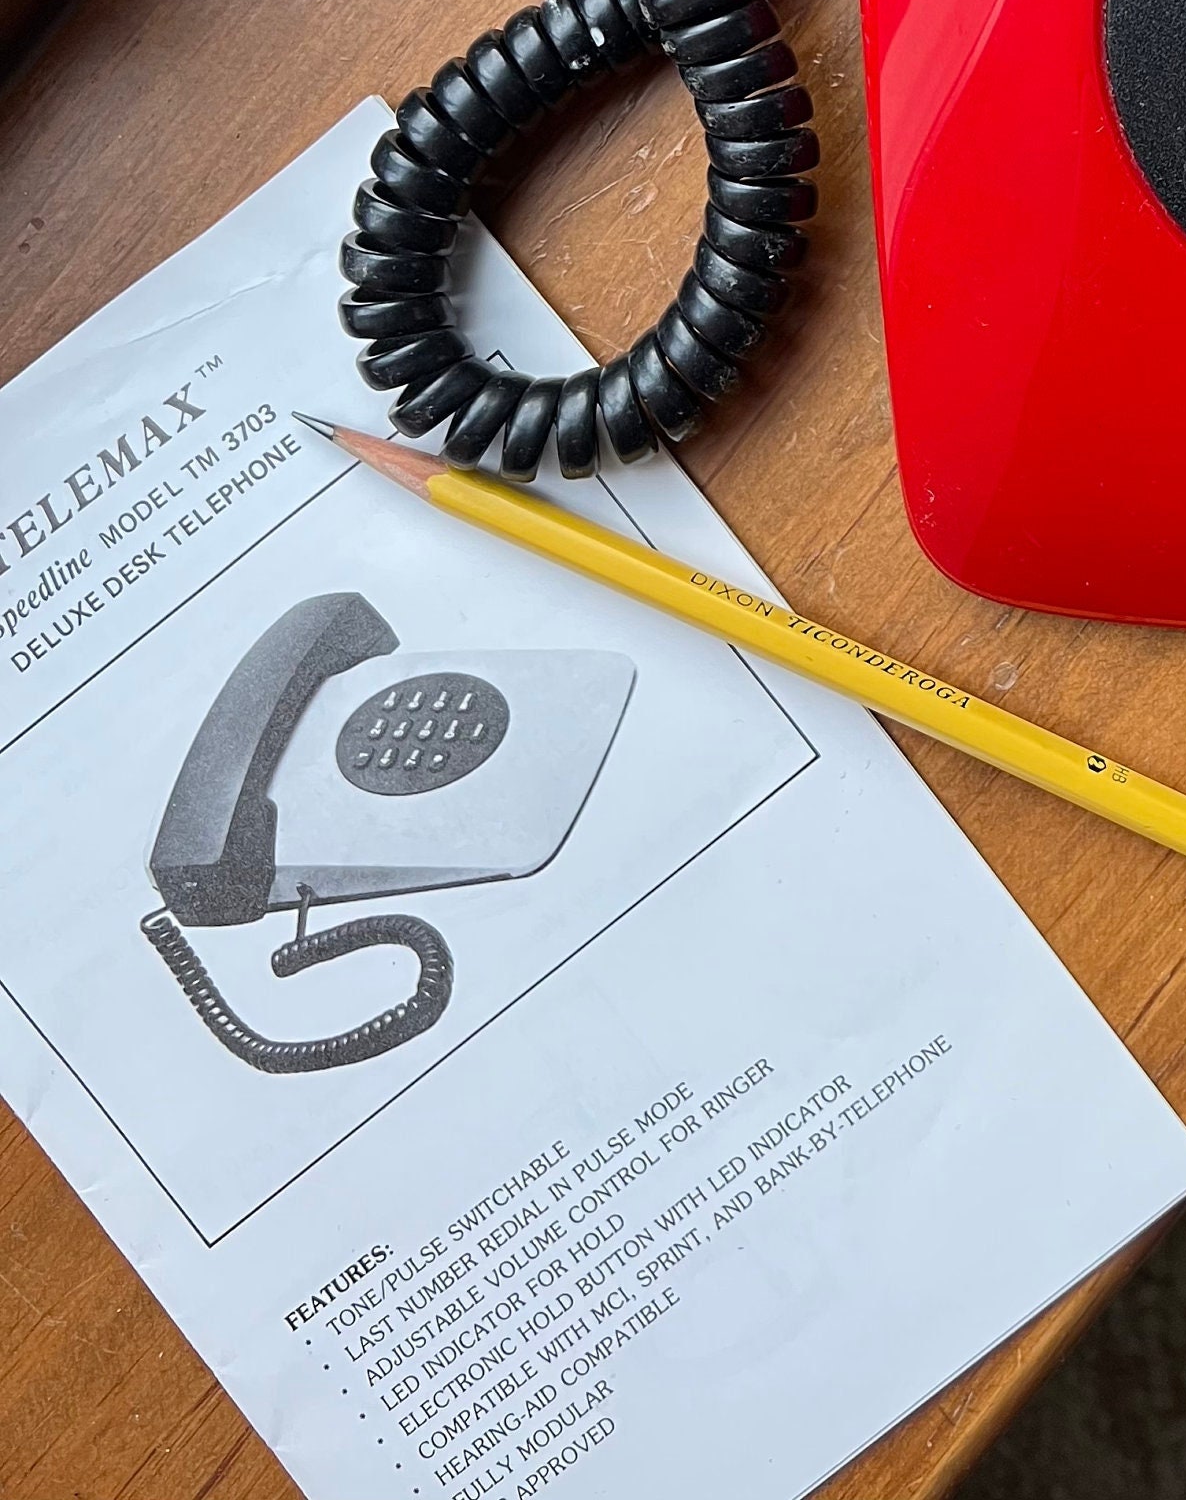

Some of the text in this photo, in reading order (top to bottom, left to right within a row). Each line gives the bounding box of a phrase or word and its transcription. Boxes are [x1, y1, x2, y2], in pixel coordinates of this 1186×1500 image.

[10, 433, 302, 673] DELUXE DESK TELEPHONE
[98, 480, 184, 549] MODEL
[179, 445, 220, 480] TM
[221, 403, 277, 451] 3703
[690, 572, 970, 708] DIXON TICONDEROGA
[283, 1244, 394, 1332] FEATURES:
[325, 1139, 570, 1336] TONE/PULSE SWITCHABLE
[343, 1081, 694, 1362] LAST NUMBER REDIAL IN PULSE MODE
[366, 1058, 775, 1388] ADJUSTABLE VOLUME CONTROL FOR RINGER
[379, 1213, 624, 1412] LED INDICATOR FOR HOLD
[398, 1074, 852, 1437] ELECTRONIC HOLD BUTTON WITH LED INDICATOR
[418, 1359, 539, 1459] COMPATIBLE
[536, 1317, 591, 1364] WITH
[589, 1286, 637, 1325] MCI,
[713, 1190, 753, 1231] AND
[753, 1034, 952, 1196] BANK-BY-TELEPHONE
[433, 1286, 681, 1487] HEARING-AID COMPATIBLE
[515, 1379, 614, 1462] MODULAR
[516, 1417, 615, 1500] APPROVED
